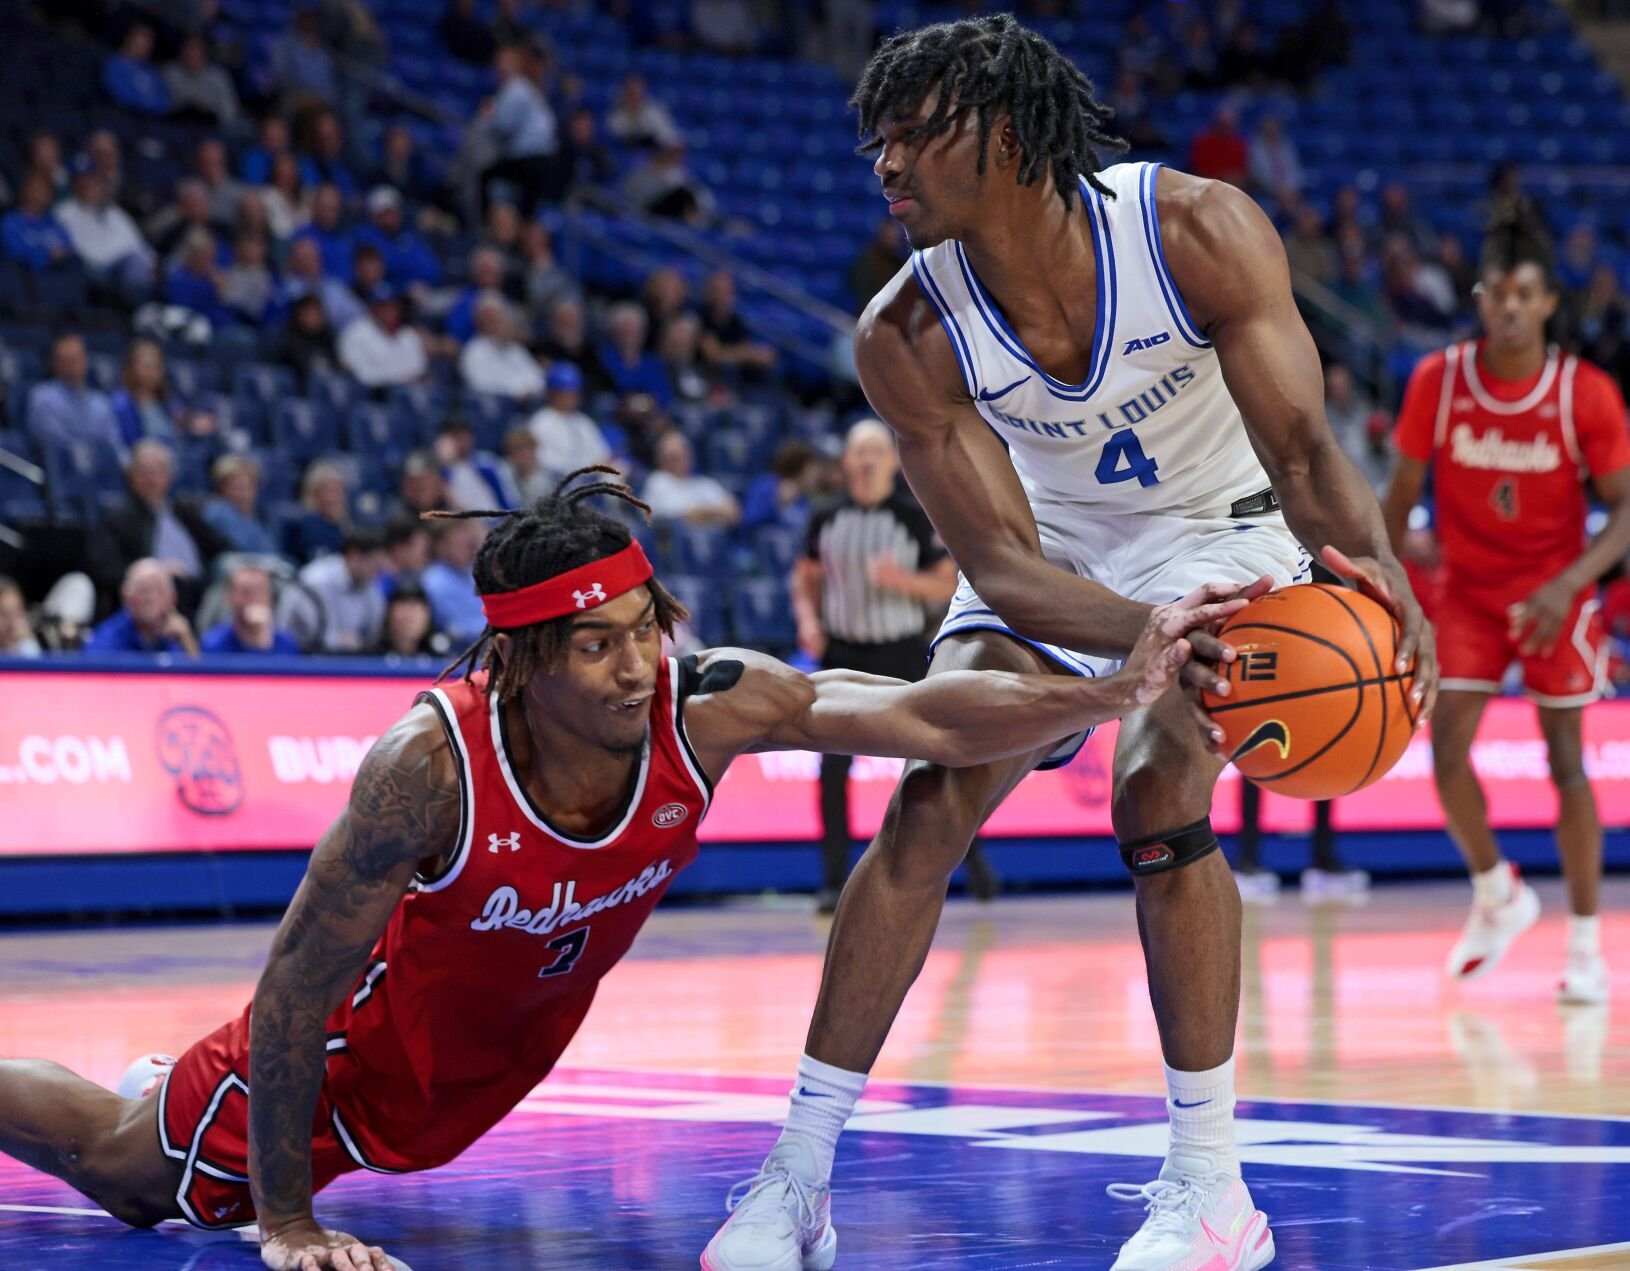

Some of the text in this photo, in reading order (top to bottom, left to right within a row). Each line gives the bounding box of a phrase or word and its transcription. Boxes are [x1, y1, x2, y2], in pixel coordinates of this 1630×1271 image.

[1096, 363, 1198, 430] LOUIS
[1094, 428, 1161, 488] 4
[470, 858, 673, 935] Redhawks
[537, 926, 591, 979] 7
